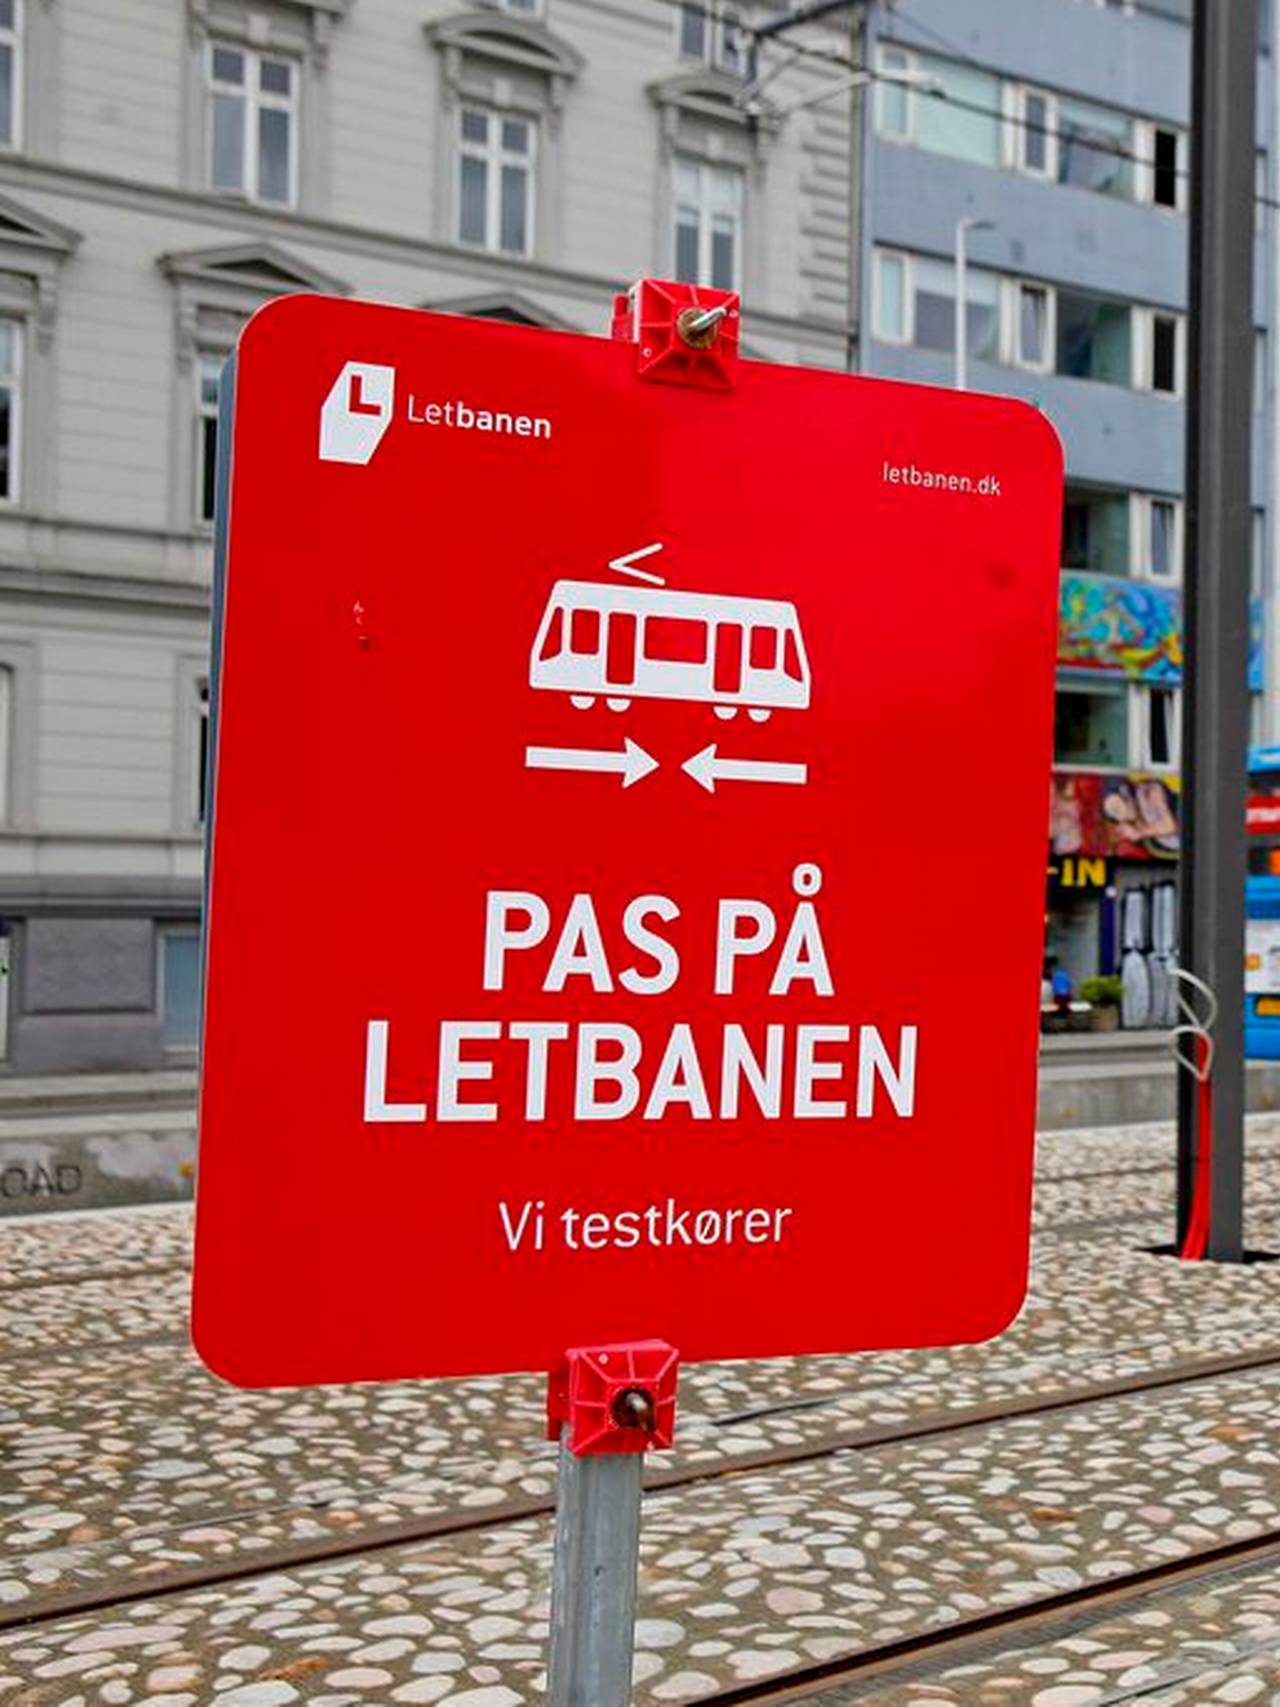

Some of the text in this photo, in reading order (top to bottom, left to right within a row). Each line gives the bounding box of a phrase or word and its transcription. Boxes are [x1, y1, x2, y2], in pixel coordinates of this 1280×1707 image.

[349, 374, 382, 416] L
[407, 394, 552, 438] Letbanen
[883, 461, 1002, 496] letbanen.dk
[483, 862, 835, 997] PAS PÅ
[362, 1019, 919, 1123] LETBANEN
[498, 1197, 793, 1251] Vi testkører
